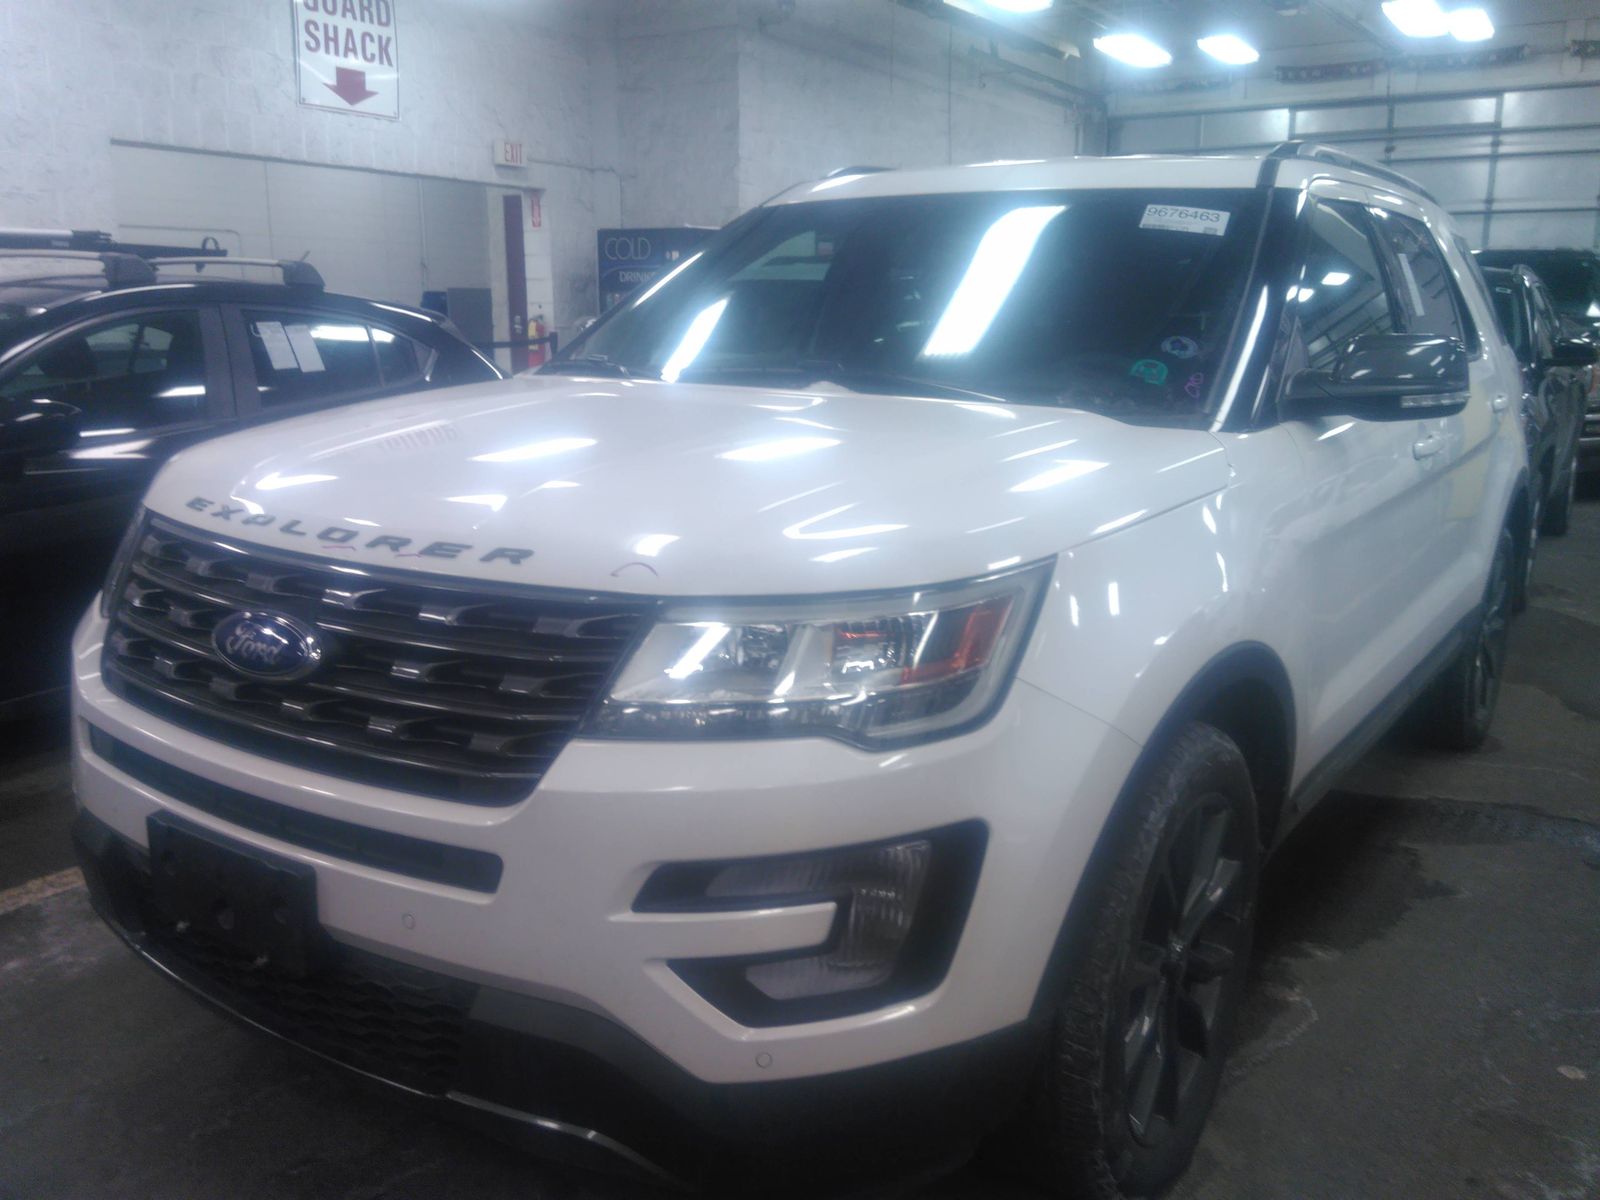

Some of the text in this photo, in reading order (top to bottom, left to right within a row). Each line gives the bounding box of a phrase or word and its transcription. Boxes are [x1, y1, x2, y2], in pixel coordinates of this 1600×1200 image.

[304, 19, 393, 67] SHACK
[504, 143, 523, 165] EXIT
[1147, 206, 1221, 222] 9676463
[605, 237, 651, 260] COLD
[619, 271, 657, 283] DRINK
[186, 496, 534, 565] EXPLORER
[225, 622, 286, 664] Ford
